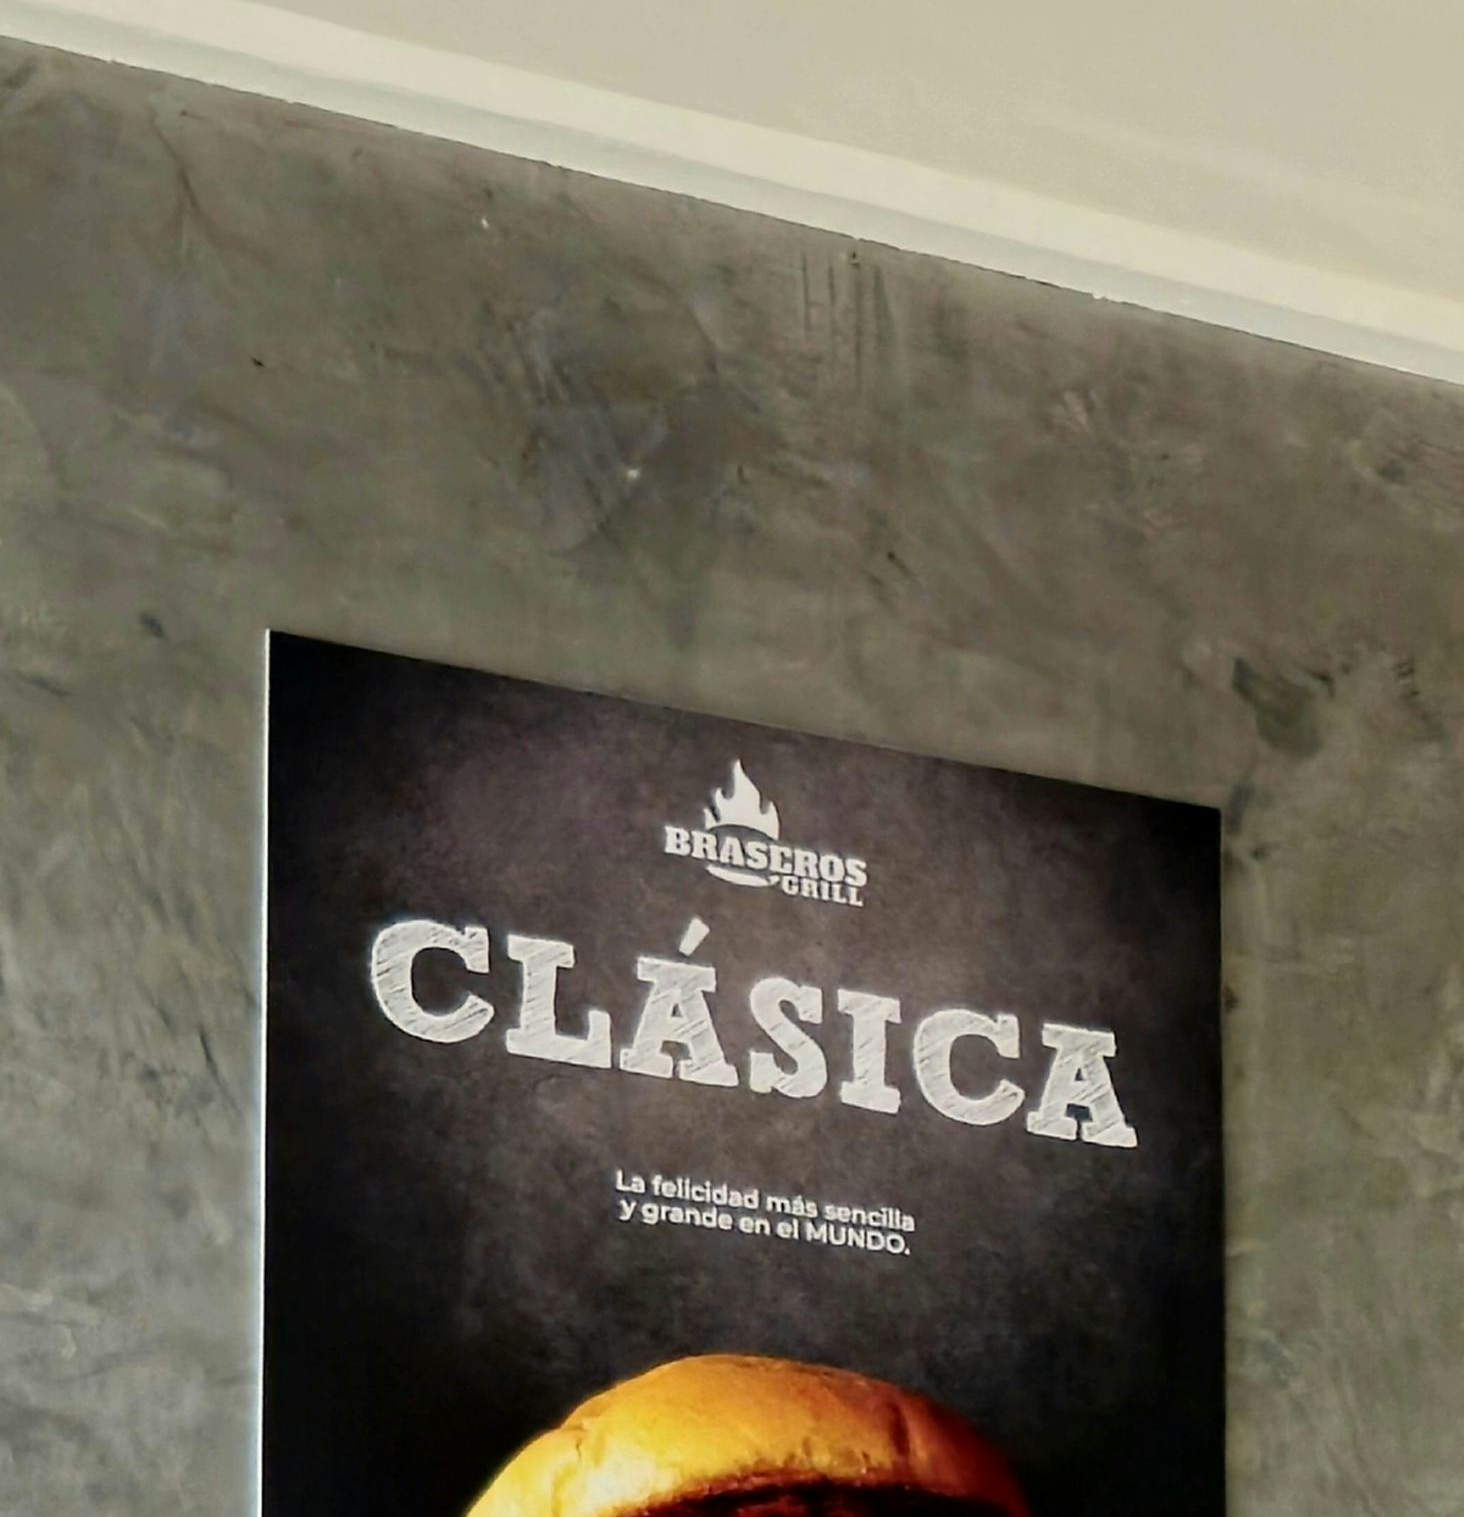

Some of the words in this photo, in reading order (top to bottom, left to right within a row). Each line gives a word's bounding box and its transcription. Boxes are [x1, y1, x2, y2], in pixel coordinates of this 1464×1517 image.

[664, 825, 868, 888] BRASEROS
[780, 874, 864, 907] GRILL
[369, 918, 1138, 1148] CLÁSICA
[615, 1169, 646, 1194] La
[650, 1175, 760, 1209] felicidad
[766, 1195, 818, 1219] más
[824, 1202, 916, 1232] sencilla
[619, 1199, 637, 1220] y
[641, 1204, 733, 1231] grande
[739, 1214, 771, 1236] en
[776, 1219, 800, 1241] el
[805, 1223, 911, 1256] MUNDO.
